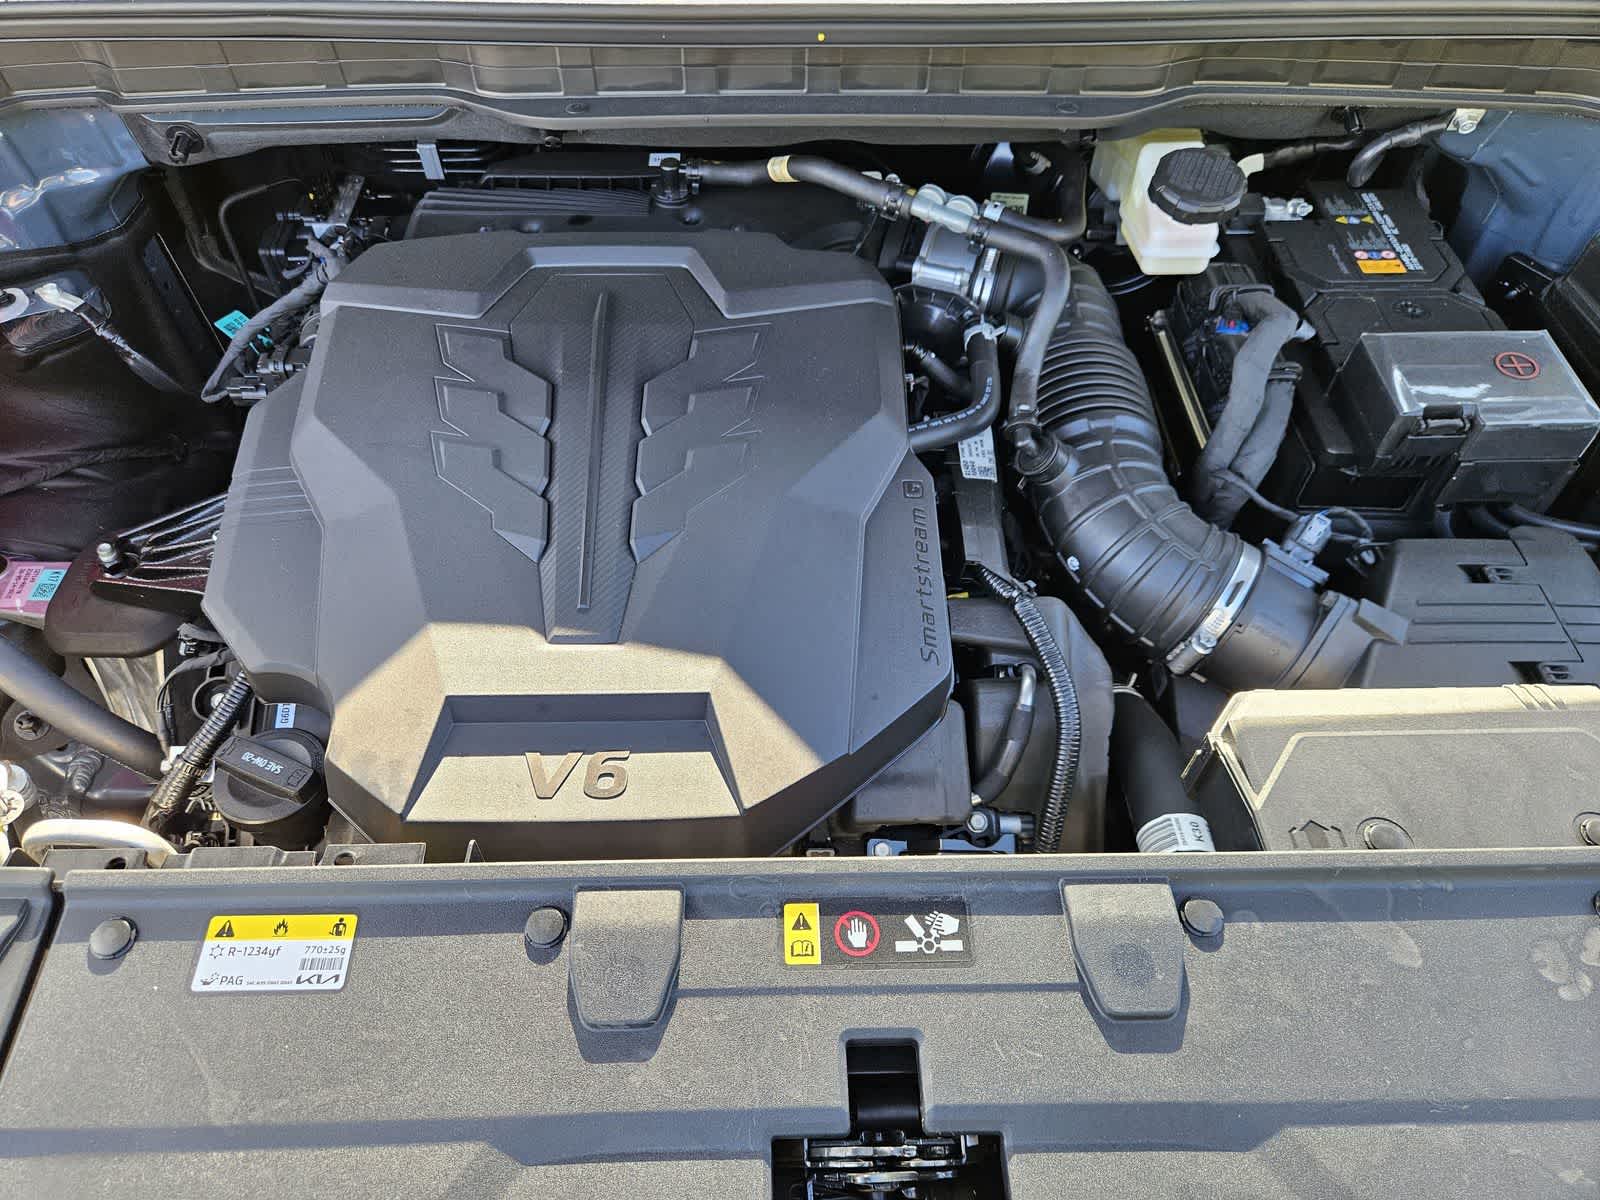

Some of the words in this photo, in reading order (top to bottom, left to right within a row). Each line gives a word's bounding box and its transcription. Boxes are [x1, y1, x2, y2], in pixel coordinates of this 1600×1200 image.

[912, 507, 940, 666] Smartstream
[241, 751, 269, 768] 0W-20
[265, 760, 284, 774] SAE
[525, 750, 630, 800] V6
[1190, 821, 1205, 842] K30
[227, 945, 283, 959] R-1234yf
[304, 945, 346, 955] 770±25g
[219, 975, 244, 986] PAG
